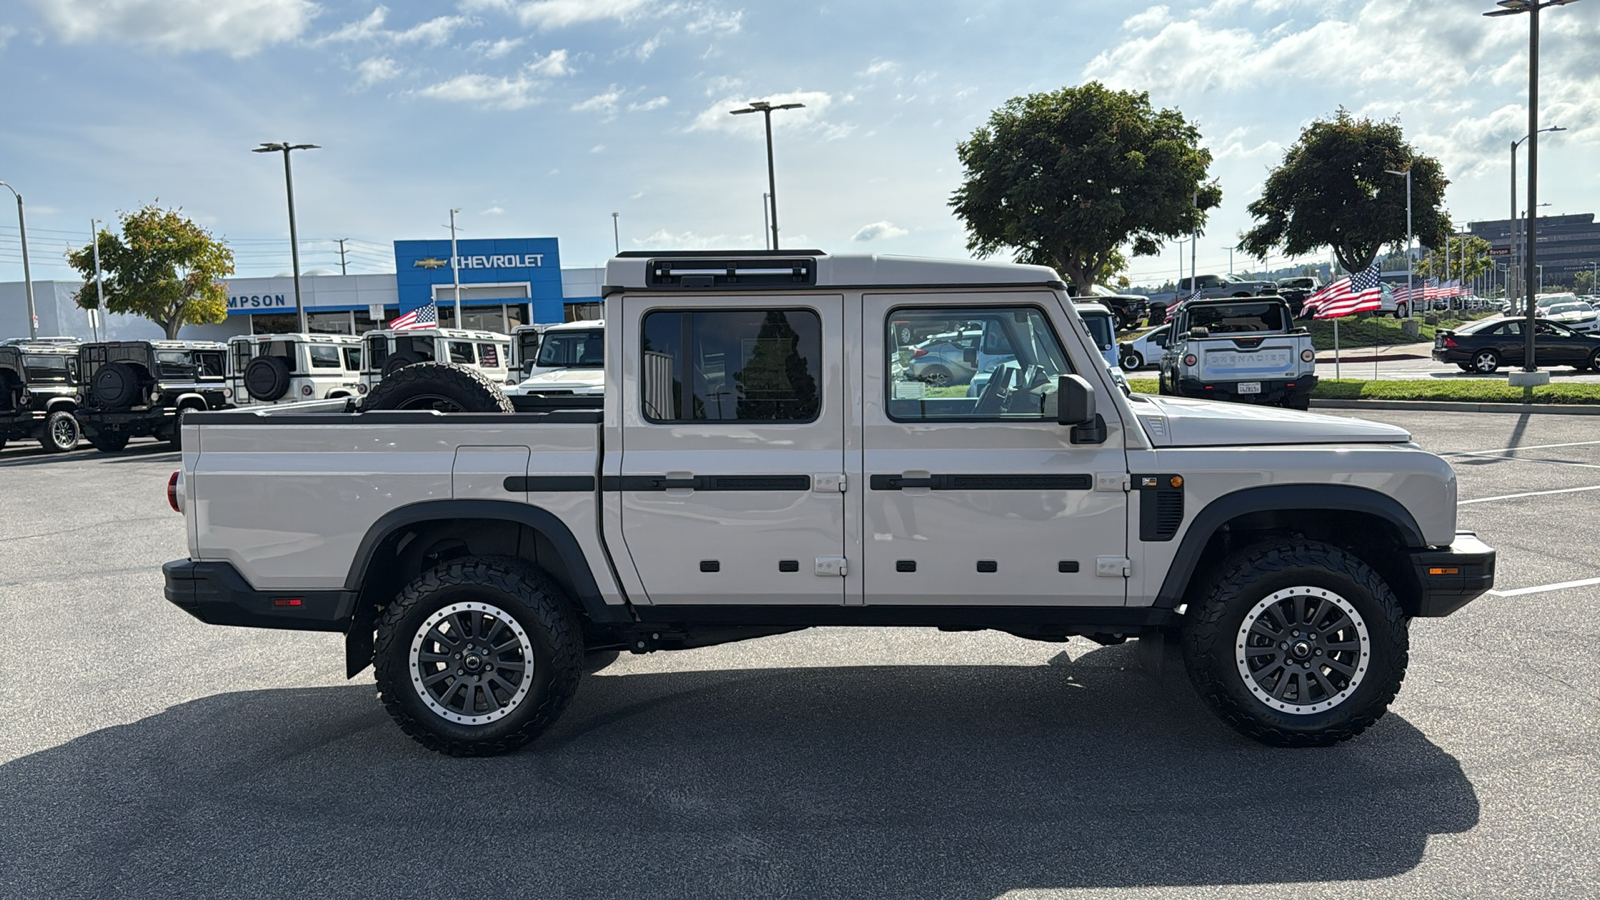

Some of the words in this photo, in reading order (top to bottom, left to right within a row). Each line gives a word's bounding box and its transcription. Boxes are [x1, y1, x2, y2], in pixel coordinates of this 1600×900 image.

[451, 254, 543, 268] CHEVROLET
[226, 295, 285, 307] MPSON
[1211, 354, 1286, 363] GRENADIER
